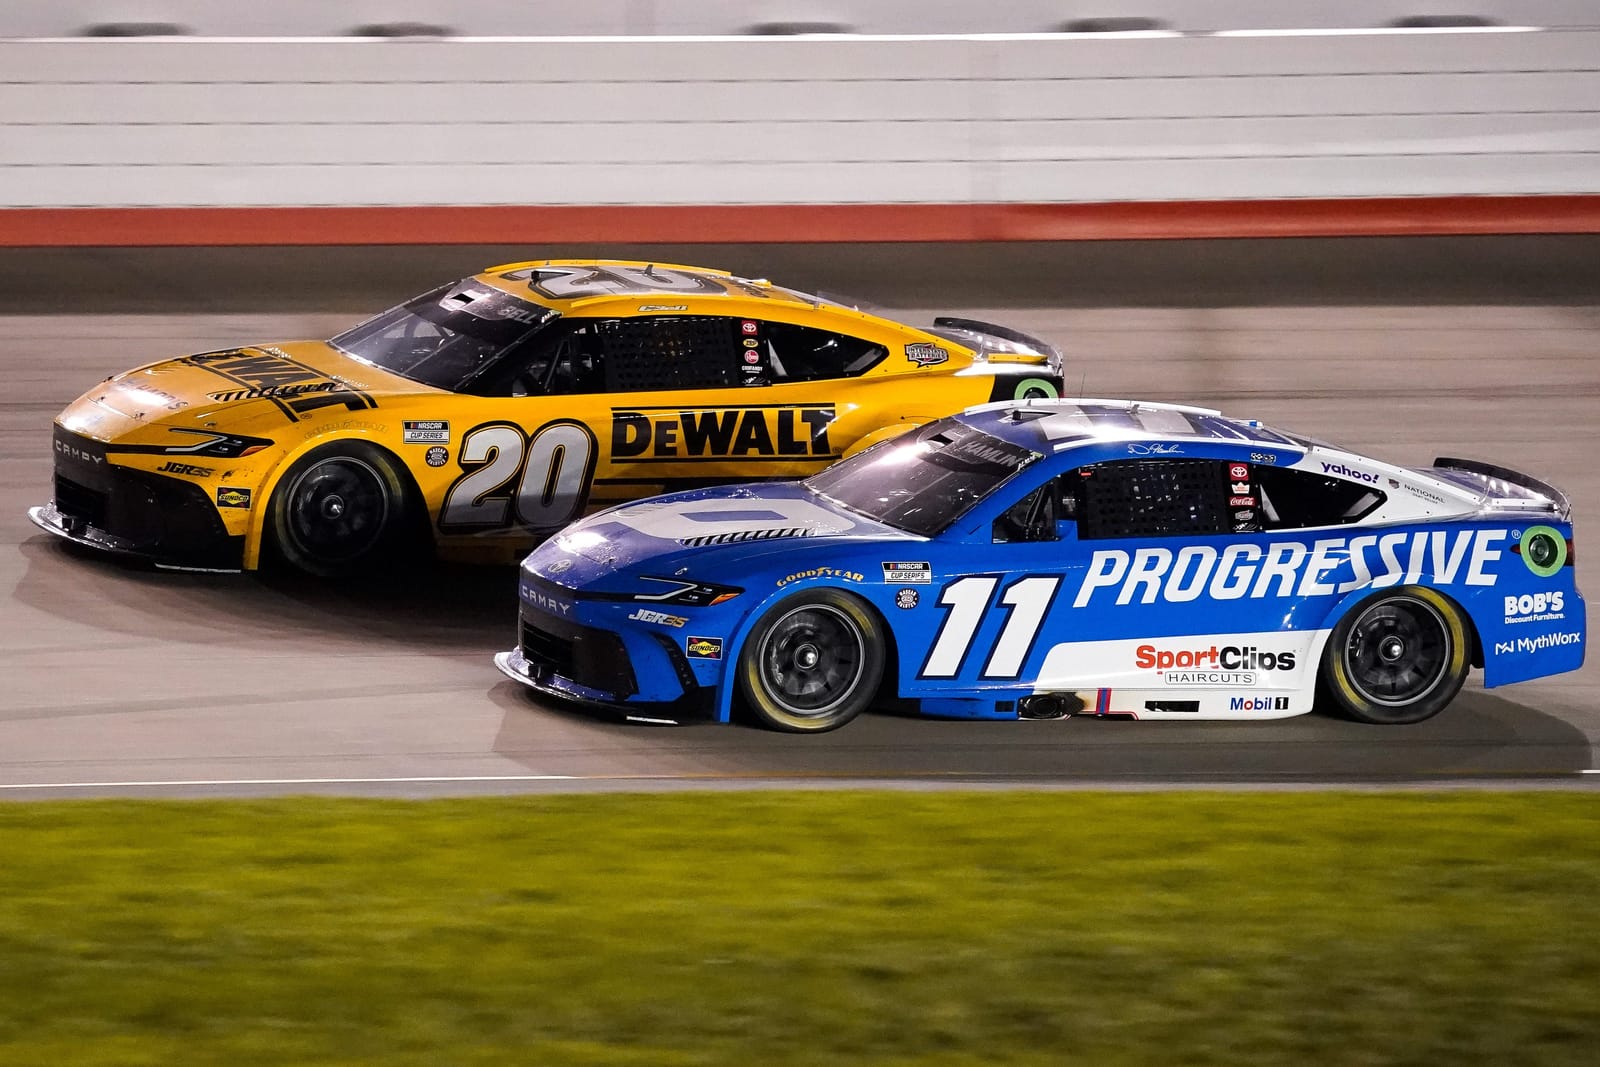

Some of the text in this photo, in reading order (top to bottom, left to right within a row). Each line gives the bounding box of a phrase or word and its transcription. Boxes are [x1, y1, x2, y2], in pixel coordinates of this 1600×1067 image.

[499, 305, 537, 325] BELL
[55, 439, 102, 464] CAMRY
[960, 440, 1023, 467] HAMLIN
[439, 420, 596, 532] 20
[1321, 461, 1380, 484] yahoo!
[219, 494, 249, 503] SUNOCO
[1404, 484, 1446, 504] NATIONAL
[776, 567, 864, 587] GOODYEAR
[1073, 529, 1508, 608] PROGRESSIVE
[522, 585, 570, 615] CAMRY
[1504, 591, 1564, 616] BOB'S
[919, 575, 1063, 680] 11
[1504, 616, 1533, 624] Discount
[689, 644, 720, 654] SUNOCO
[1517, 632, 1580, 654] MythWorx
[1168, 673, 1253, 683] HAIRCUTS
[1230, 697, 1289, 711] Mobil 1
